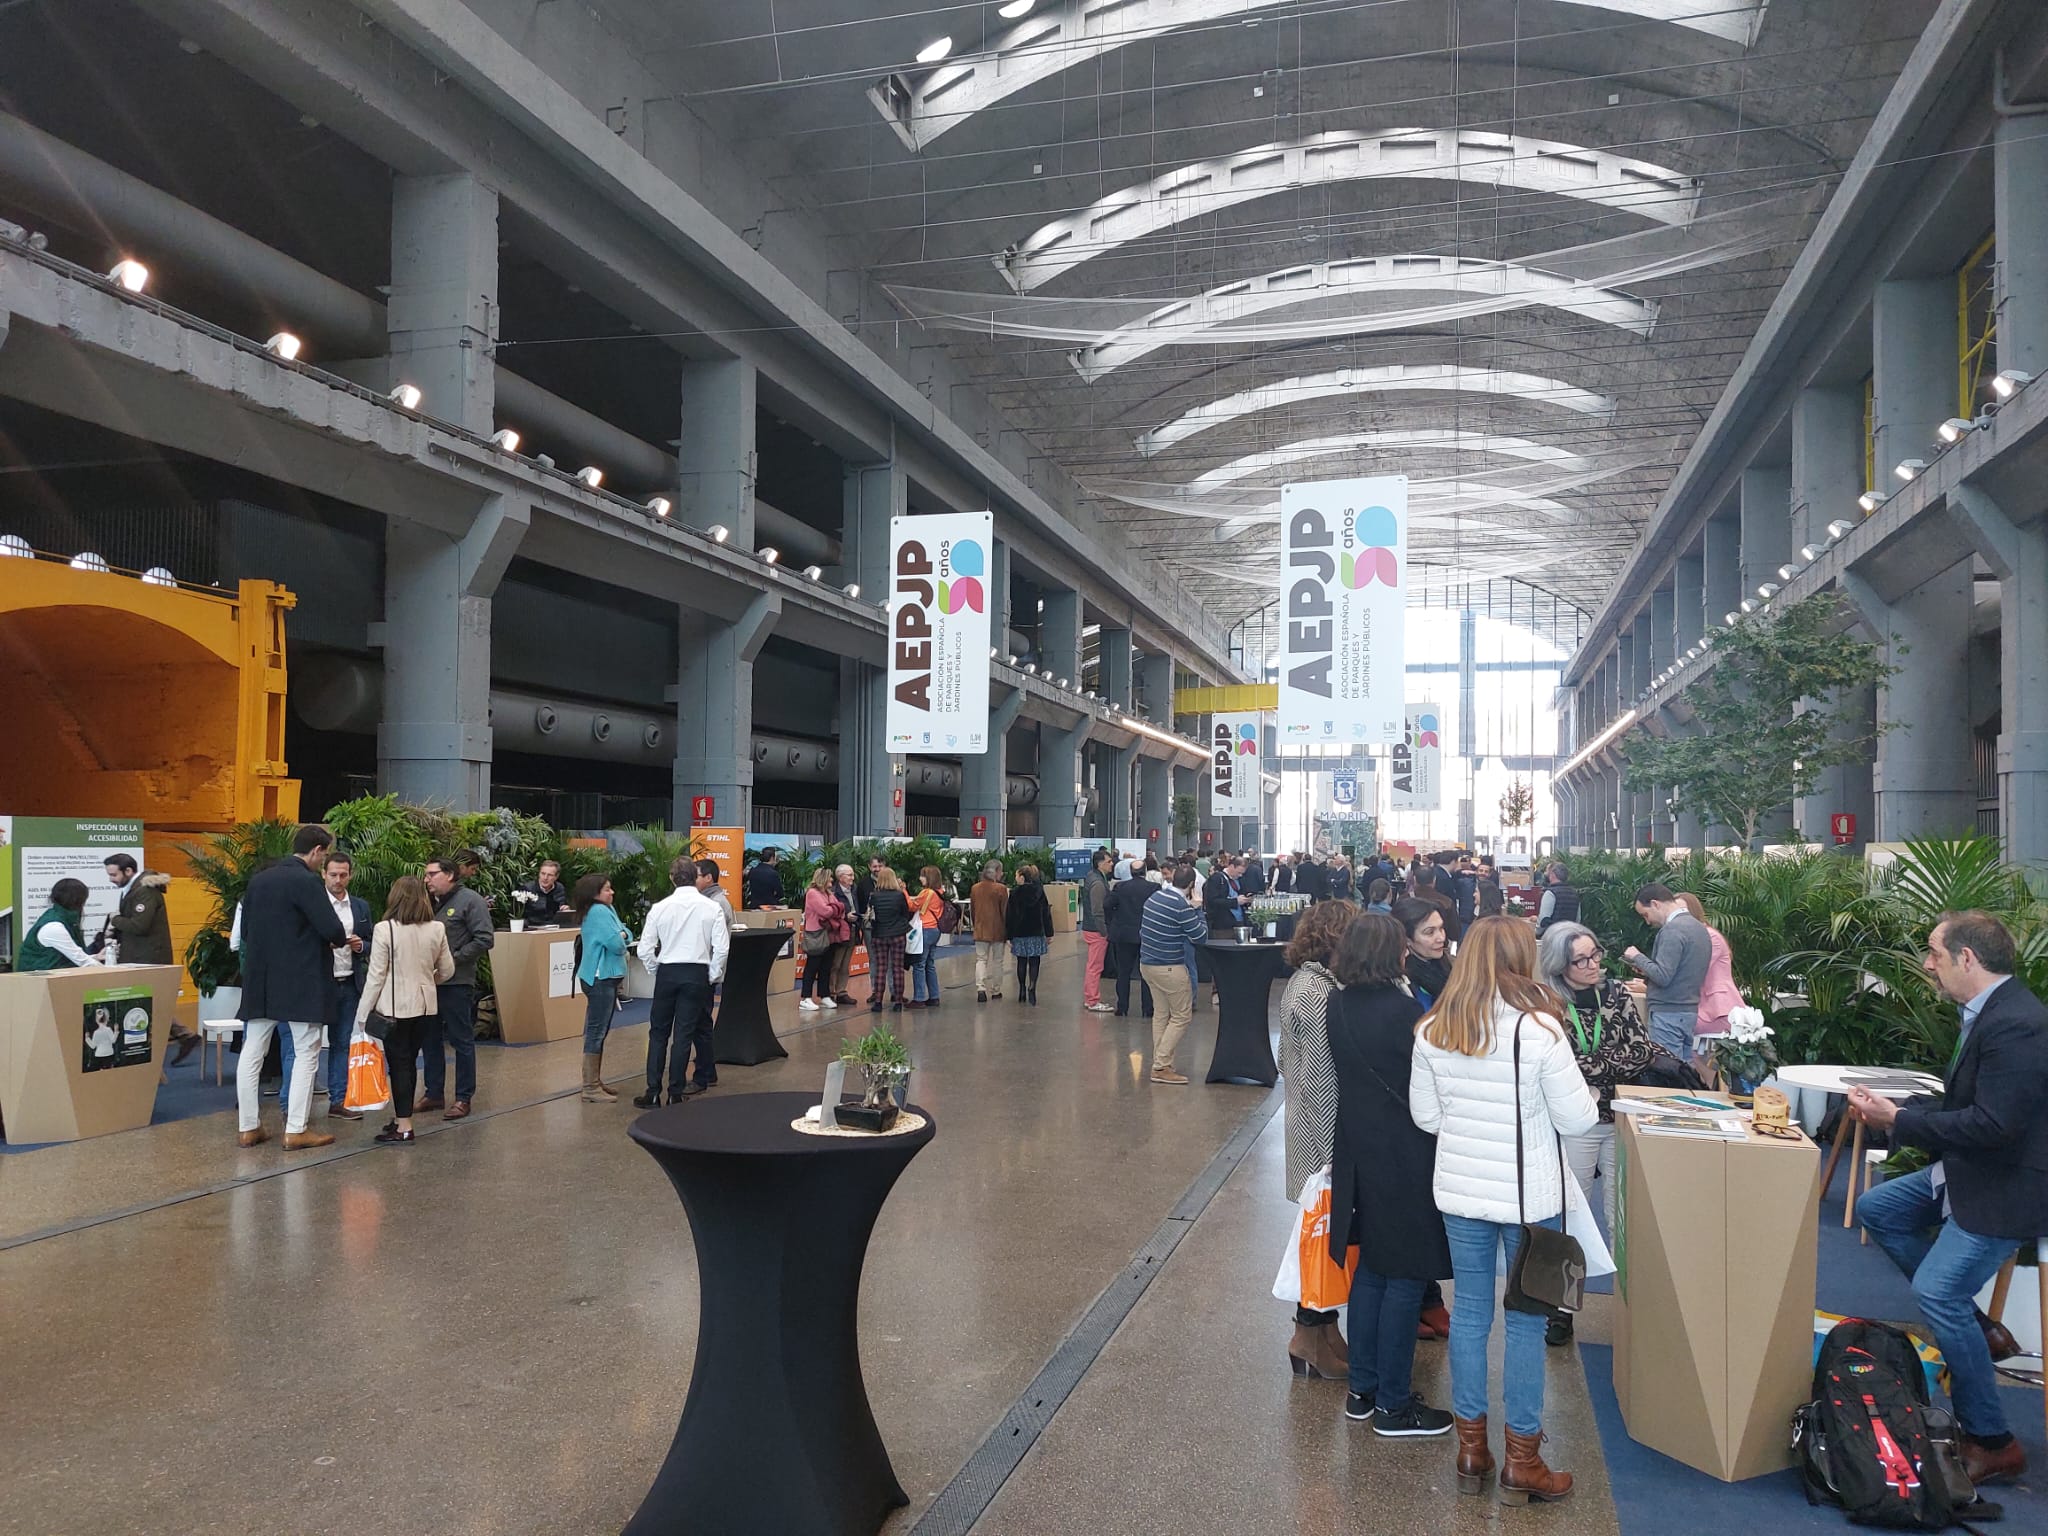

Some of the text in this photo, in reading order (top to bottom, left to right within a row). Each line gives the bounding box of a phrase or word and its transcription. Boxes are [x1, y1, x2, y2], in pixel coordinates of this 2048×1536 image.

[1341, 507, 1355, 549] años
[938, 540, 950, 578] años
[1288, 508, 1335, 699] AEPJP
[895, 540, 934, 713] AEPJP
[936, 617, 945, 661] ESPAÑOLA
[1340, 593, 1350, 699] ASOCIACIÓN ESPAÑOLA
[953, 631, 962, 713] JARDINES PÚBLICOS
[1351, 632, 1361, 699] DE PARQUES Y
[1361, 607, 1371, 699] JARDINES PÚBLICOS
[945, 663, 954, 700] PARQUES
[945, 702, 953, 713] DE
[1215, 723, 1233, 798] AEPJP
[76, 822, 138, 832] INSPECCIÓN DE LA
[1320, 811, 1369, 821] MADRID
[88, 834, 138, 842] ACCESIBILIDAD
[706, 834, 731, 842] STIHL
